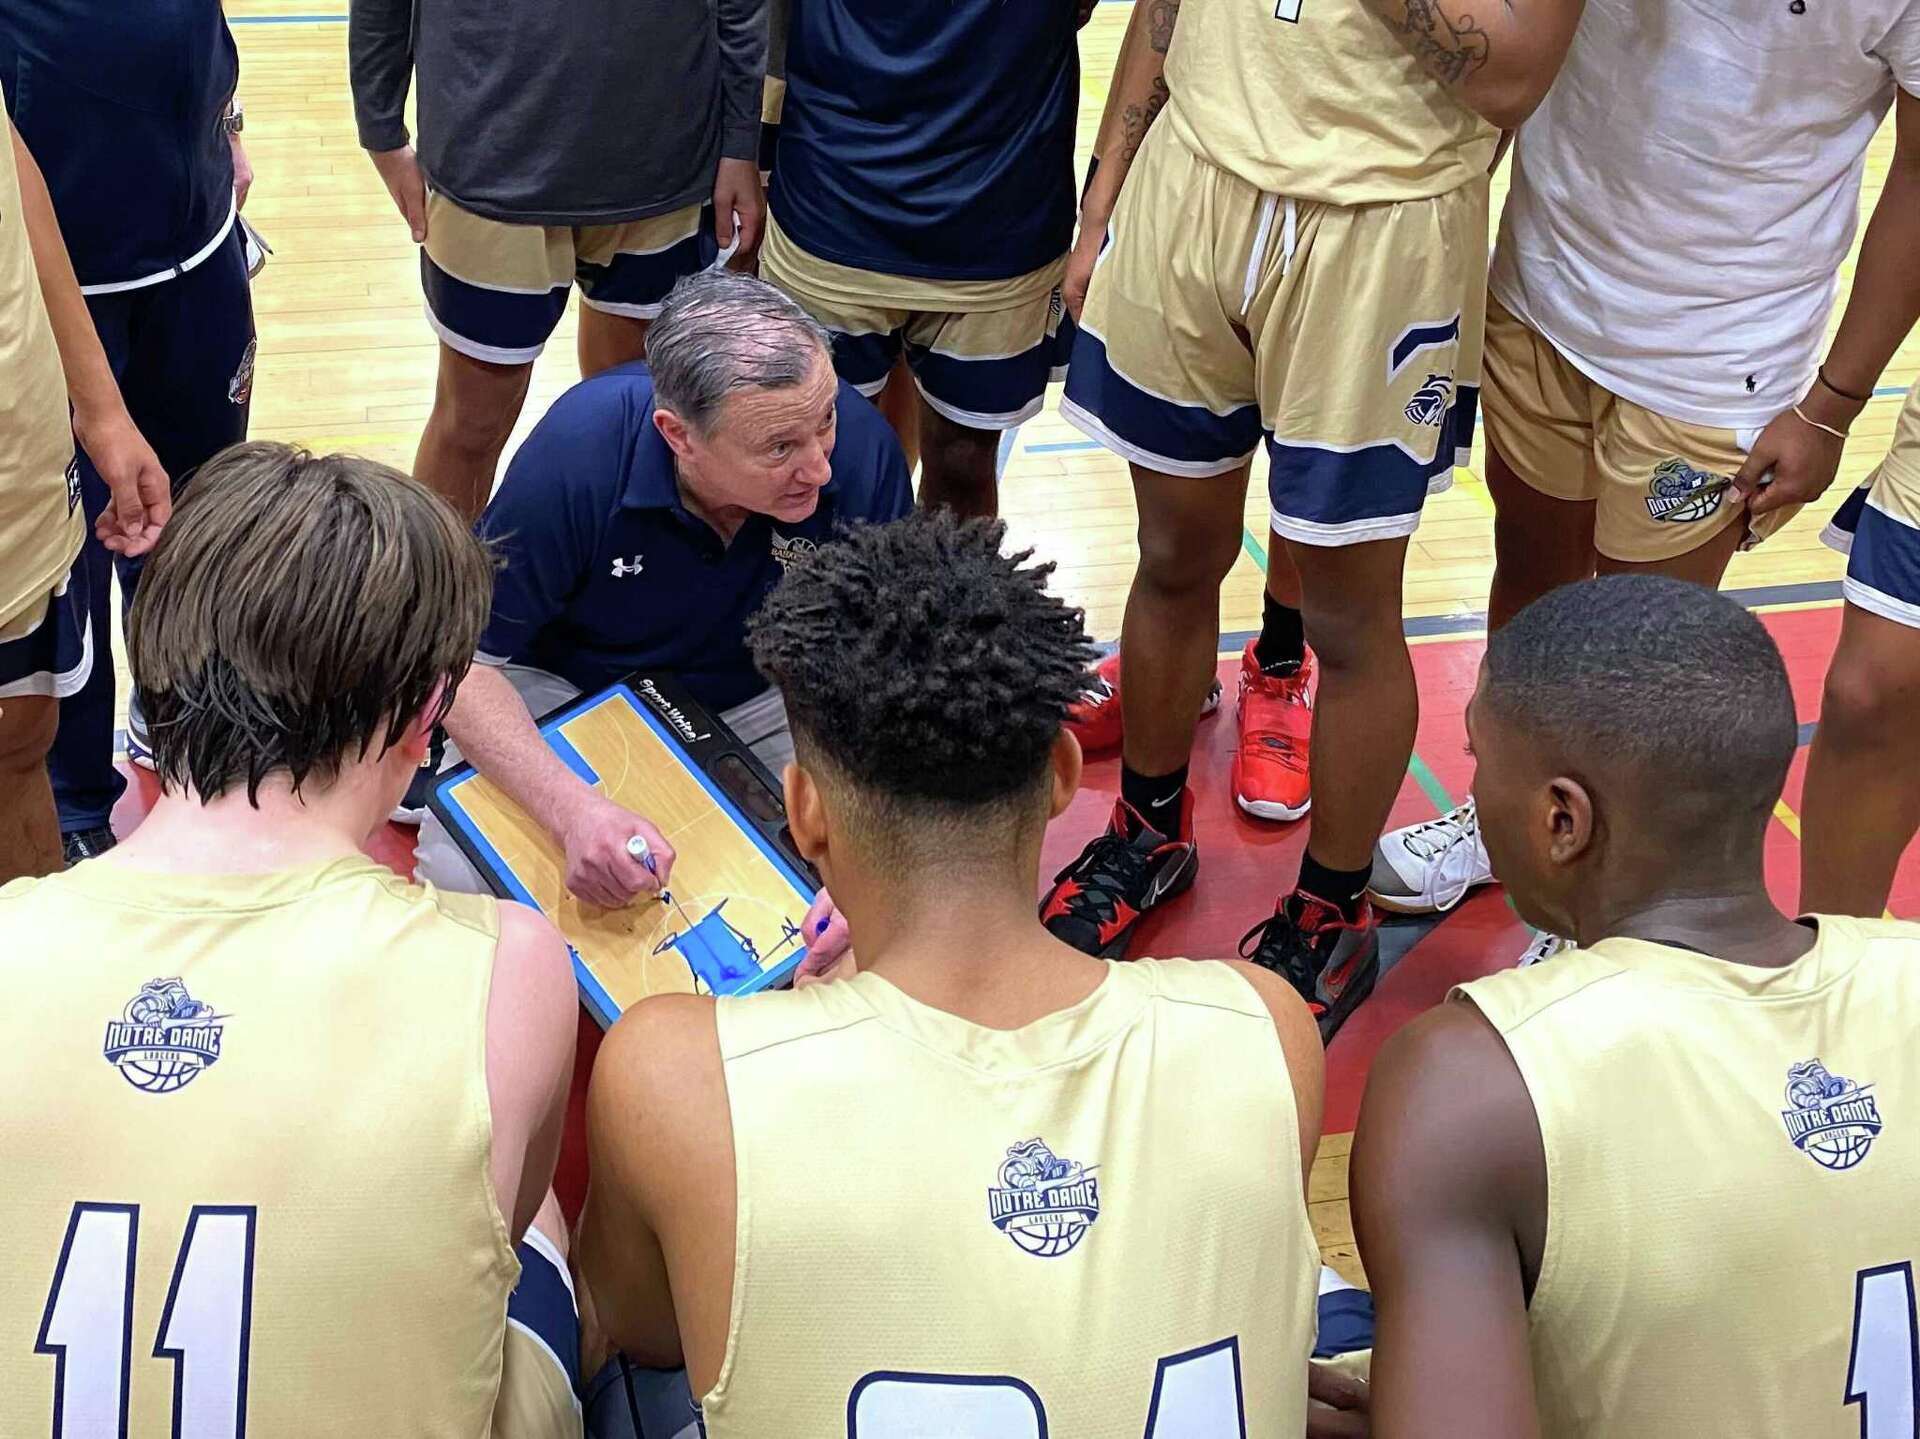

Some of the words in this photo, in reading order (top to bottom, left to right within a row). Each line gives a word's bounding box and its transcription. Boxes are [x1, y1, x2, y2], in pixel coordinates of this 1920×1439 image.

[1647, 497, 1685, 515] NOTR
[640, 679, 671, 710] Sport
[667, 708, 711, 742] Write!
[106, 1023, 166, 1051] NOTRE
[169, 1025, 220, 1056] DAME
[1784, 1109, 1831, 1139] NOTRE
[1830, 1099, 1878, 1122] DAME
[990, 1189, 1045, 1217] NOTRE
[1047, 1180, 1097, 1207] DAME
[33, 1201, 257, 1439] 11
